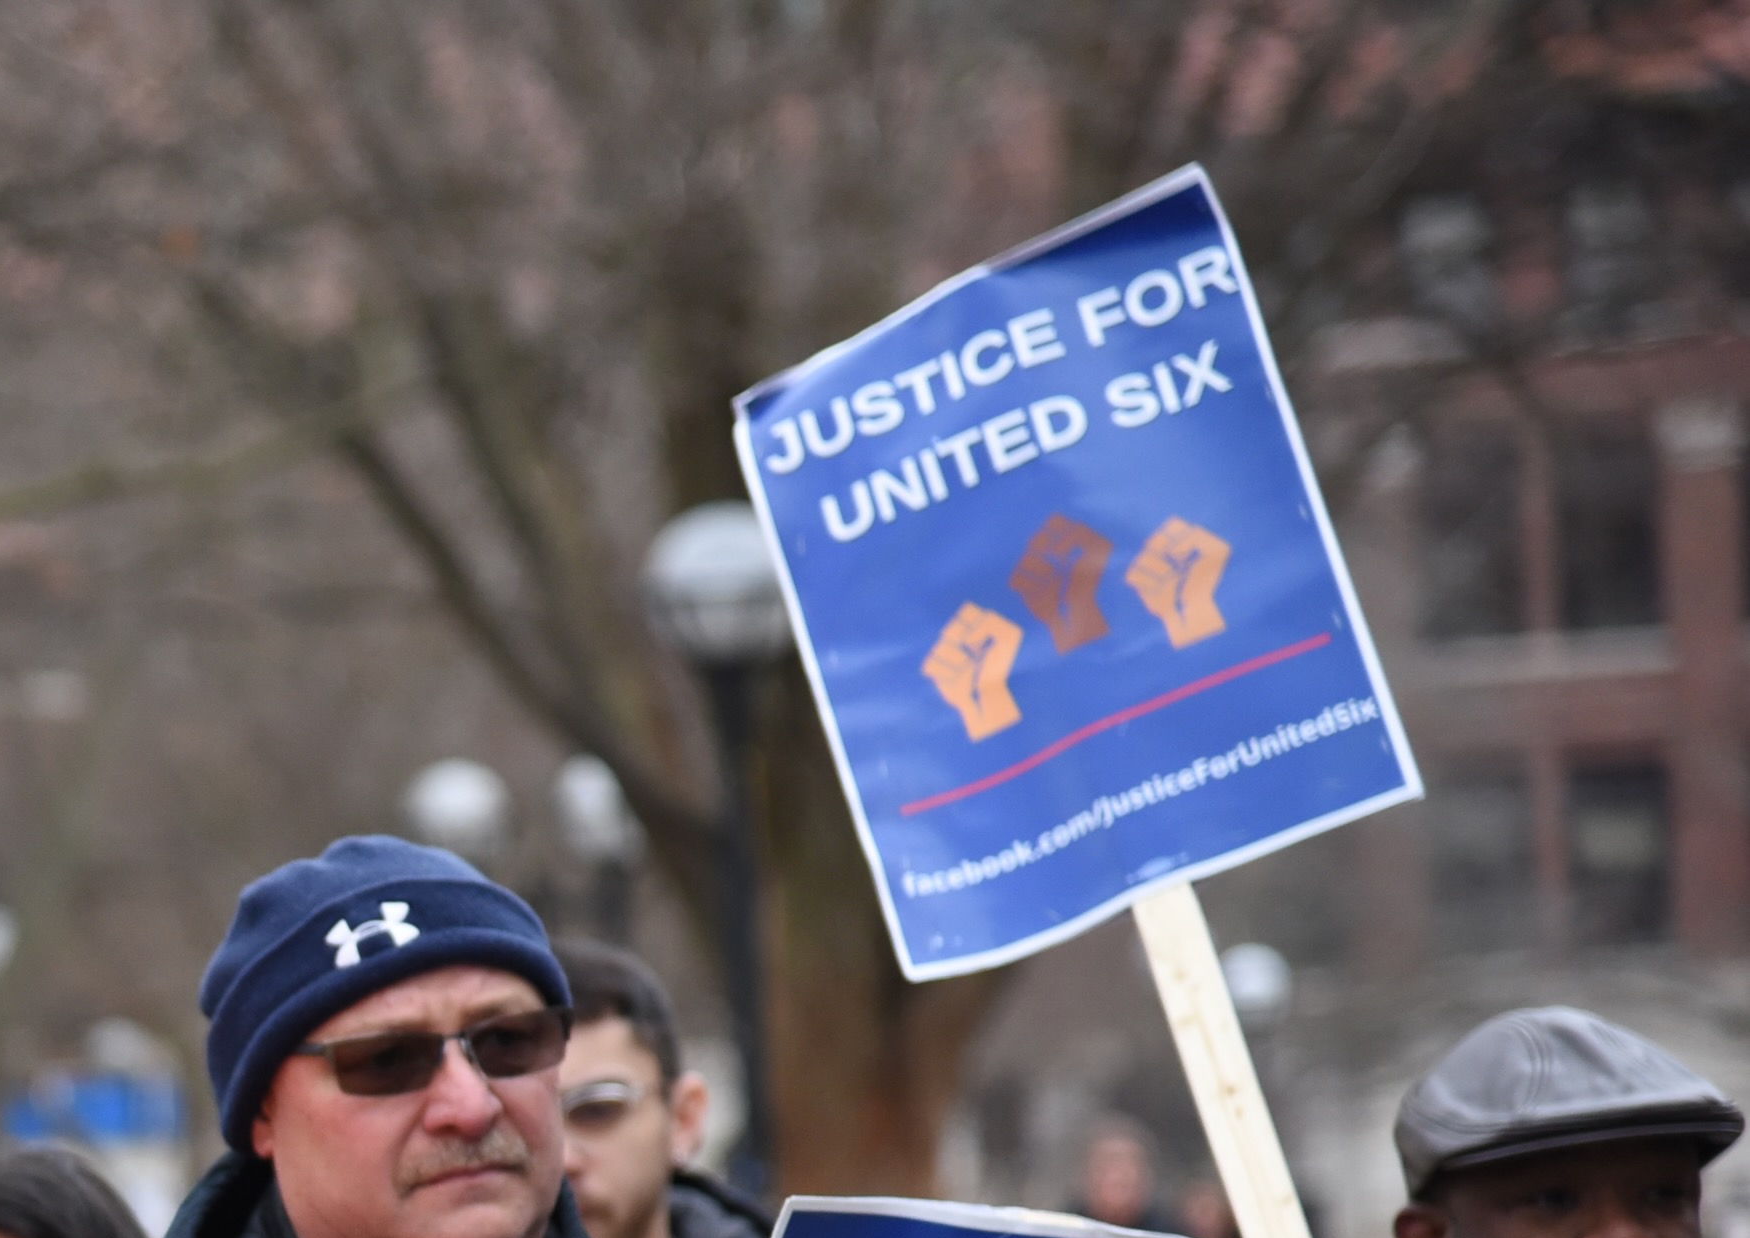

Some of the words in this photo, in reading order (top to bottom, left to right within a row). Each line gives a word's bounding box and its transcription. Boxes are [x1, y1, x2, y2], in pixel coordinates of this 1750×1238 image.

[765, 308, 1066, 474] JUSTICE
[1076, 245, 1239, 347] FOR
[820, 396, 1088, 542] UNITED
[1104, 339, 1233, 428] SIX
[901, 695, 1381, 899] facebook.com/JusticeForUnitedSix
